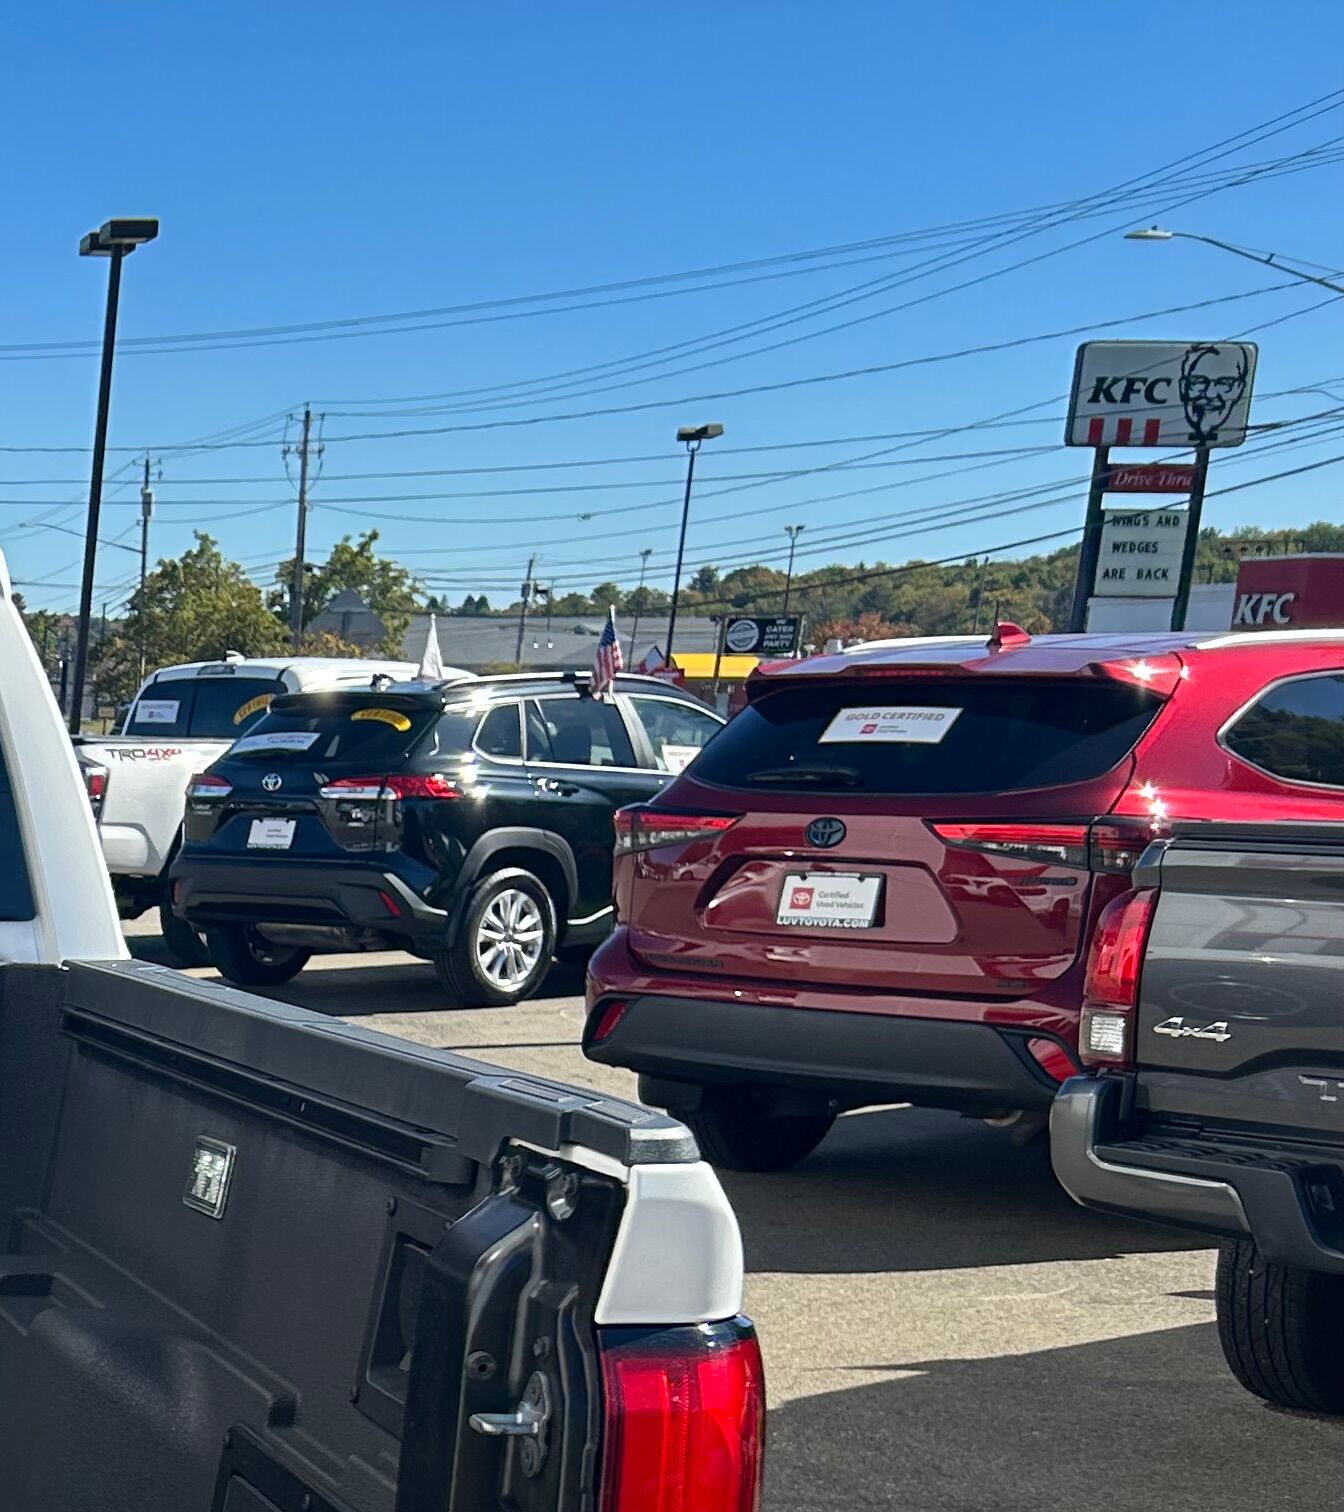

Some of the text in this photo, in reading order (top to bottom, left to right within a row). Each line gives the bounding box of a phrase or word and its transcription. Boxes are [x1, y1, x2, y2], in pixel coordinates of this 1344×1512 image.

[1087, 376, 1172, 404] KFC
[1114, 470, 1153, 486] Drive
[1112, 514, 1180, 527] WINGS AND
[1112, 541, 1159, 554] WEDGES
[1102, 567, 1169, 580] ARE BACK
[1233, 592, 1295, 625] KFC
[845, 712, 946, 721] GOLD CERTIFIED
[818, 891, 850, 899] Certified
